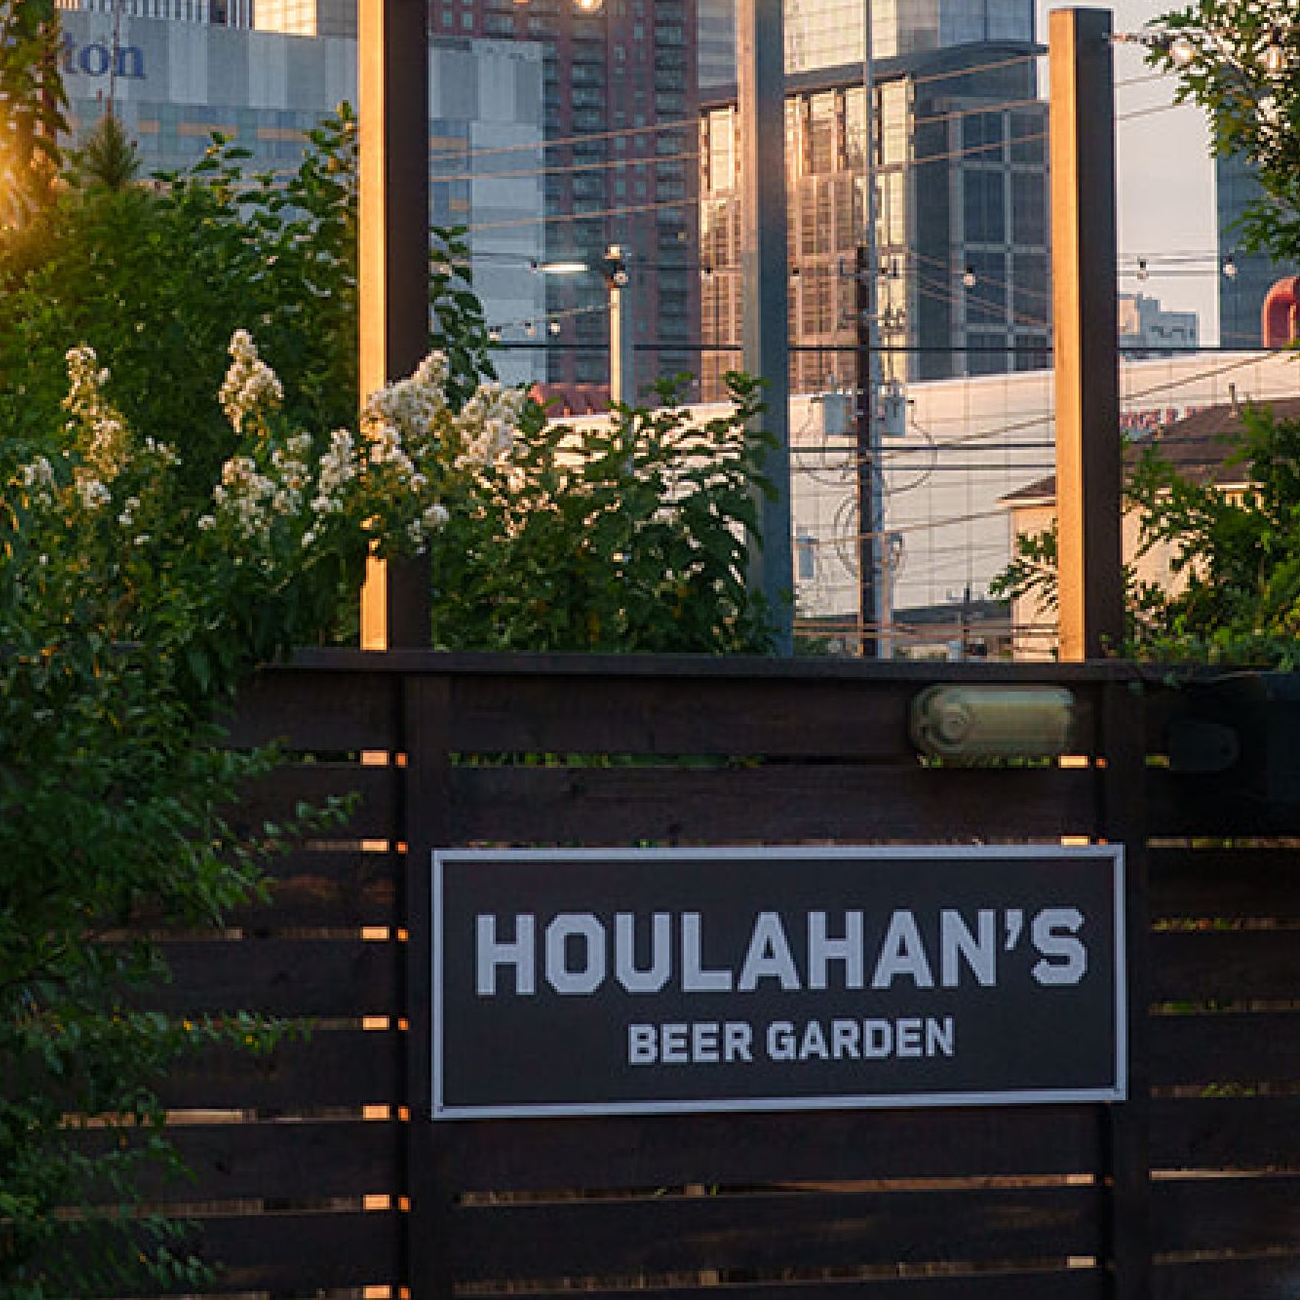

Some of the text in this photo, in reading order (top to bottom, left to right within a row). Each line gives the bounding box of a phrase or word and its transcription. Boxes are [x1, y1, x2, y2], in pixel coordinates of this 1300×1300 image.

[476, 908, 1088, 995] HOULAHAN'S
[629, 1017, 954, 1065] BEER GARDEN
